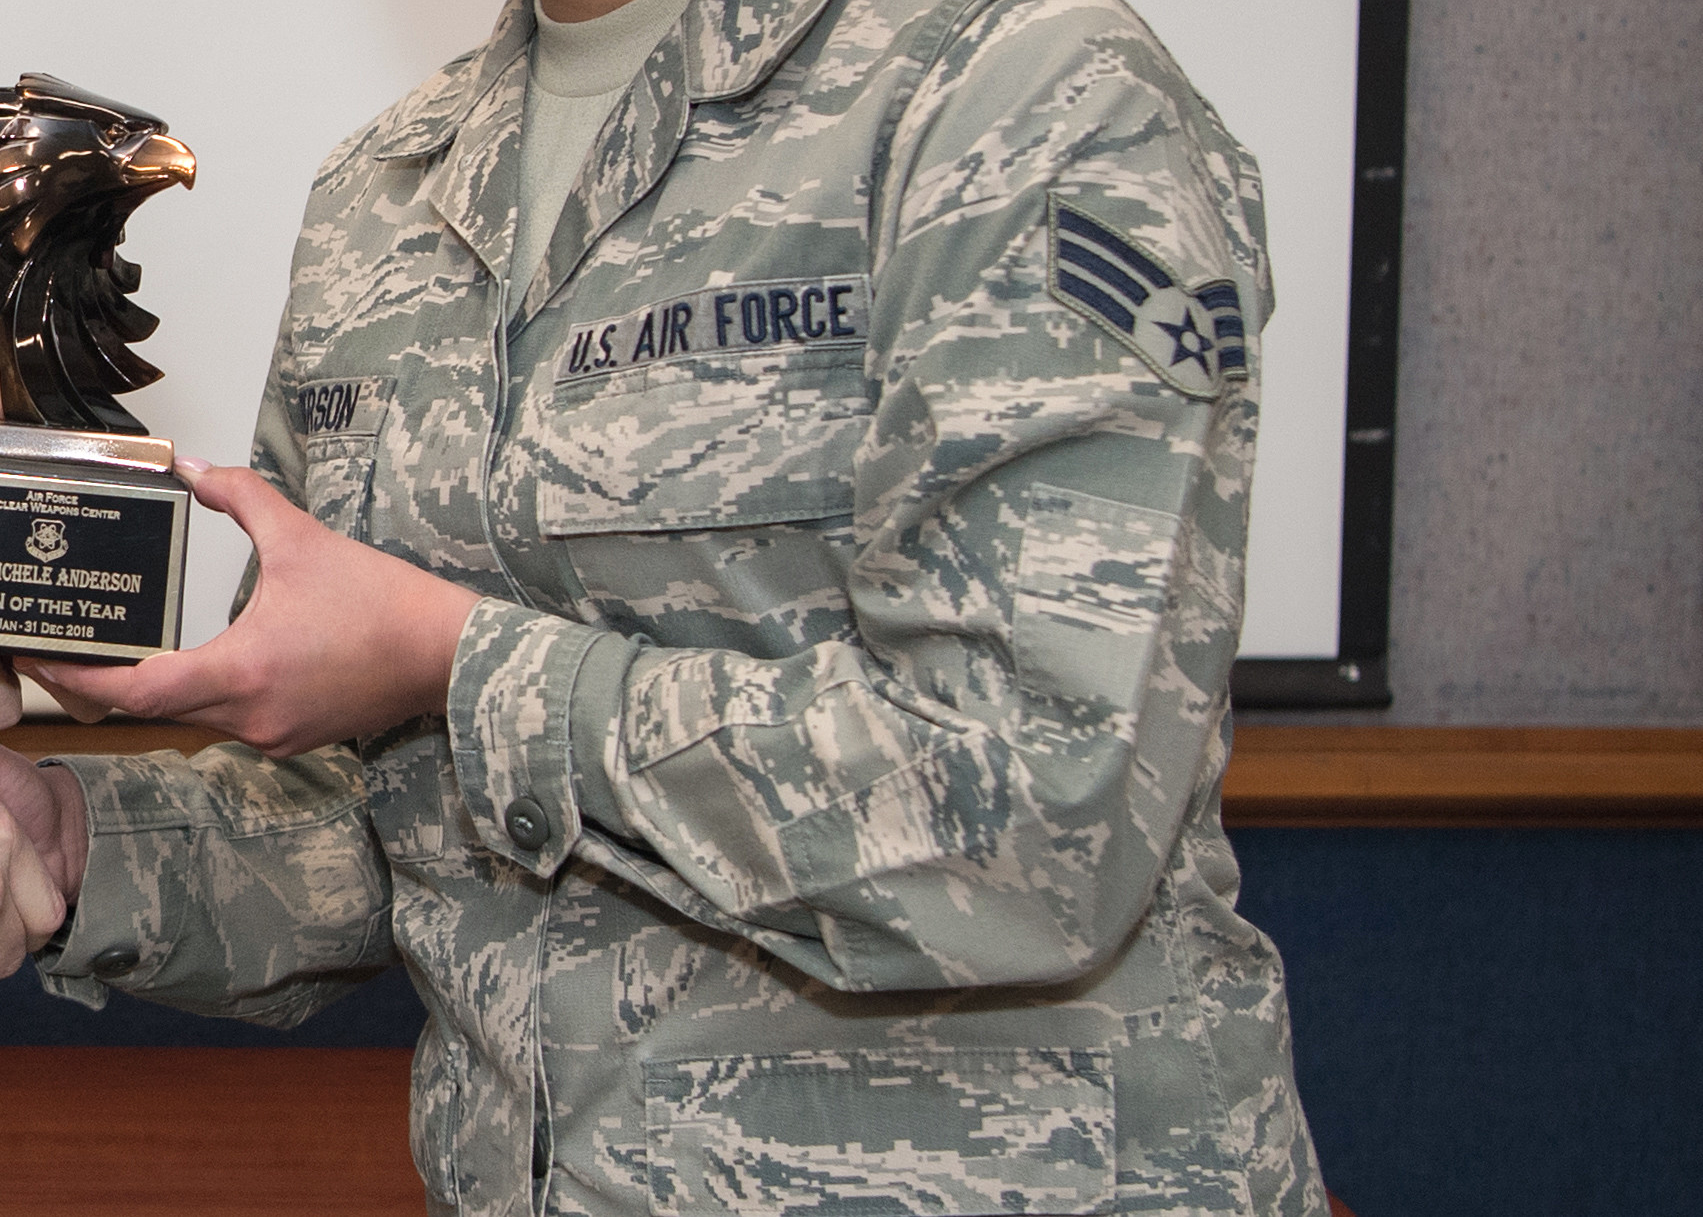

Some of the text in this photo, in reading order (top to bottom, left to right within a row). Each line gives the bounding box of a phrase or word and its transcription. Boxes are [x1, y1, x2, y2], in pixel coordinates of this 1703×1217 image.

[568, 284, 856, 373] U.S. AIR FORCE
[56, 568, 143, 593] ANDERSON
[9, 596, 35, 612] OF
[37, 598, 73, 616] THE
[65, 624, 94, 638] 2018
